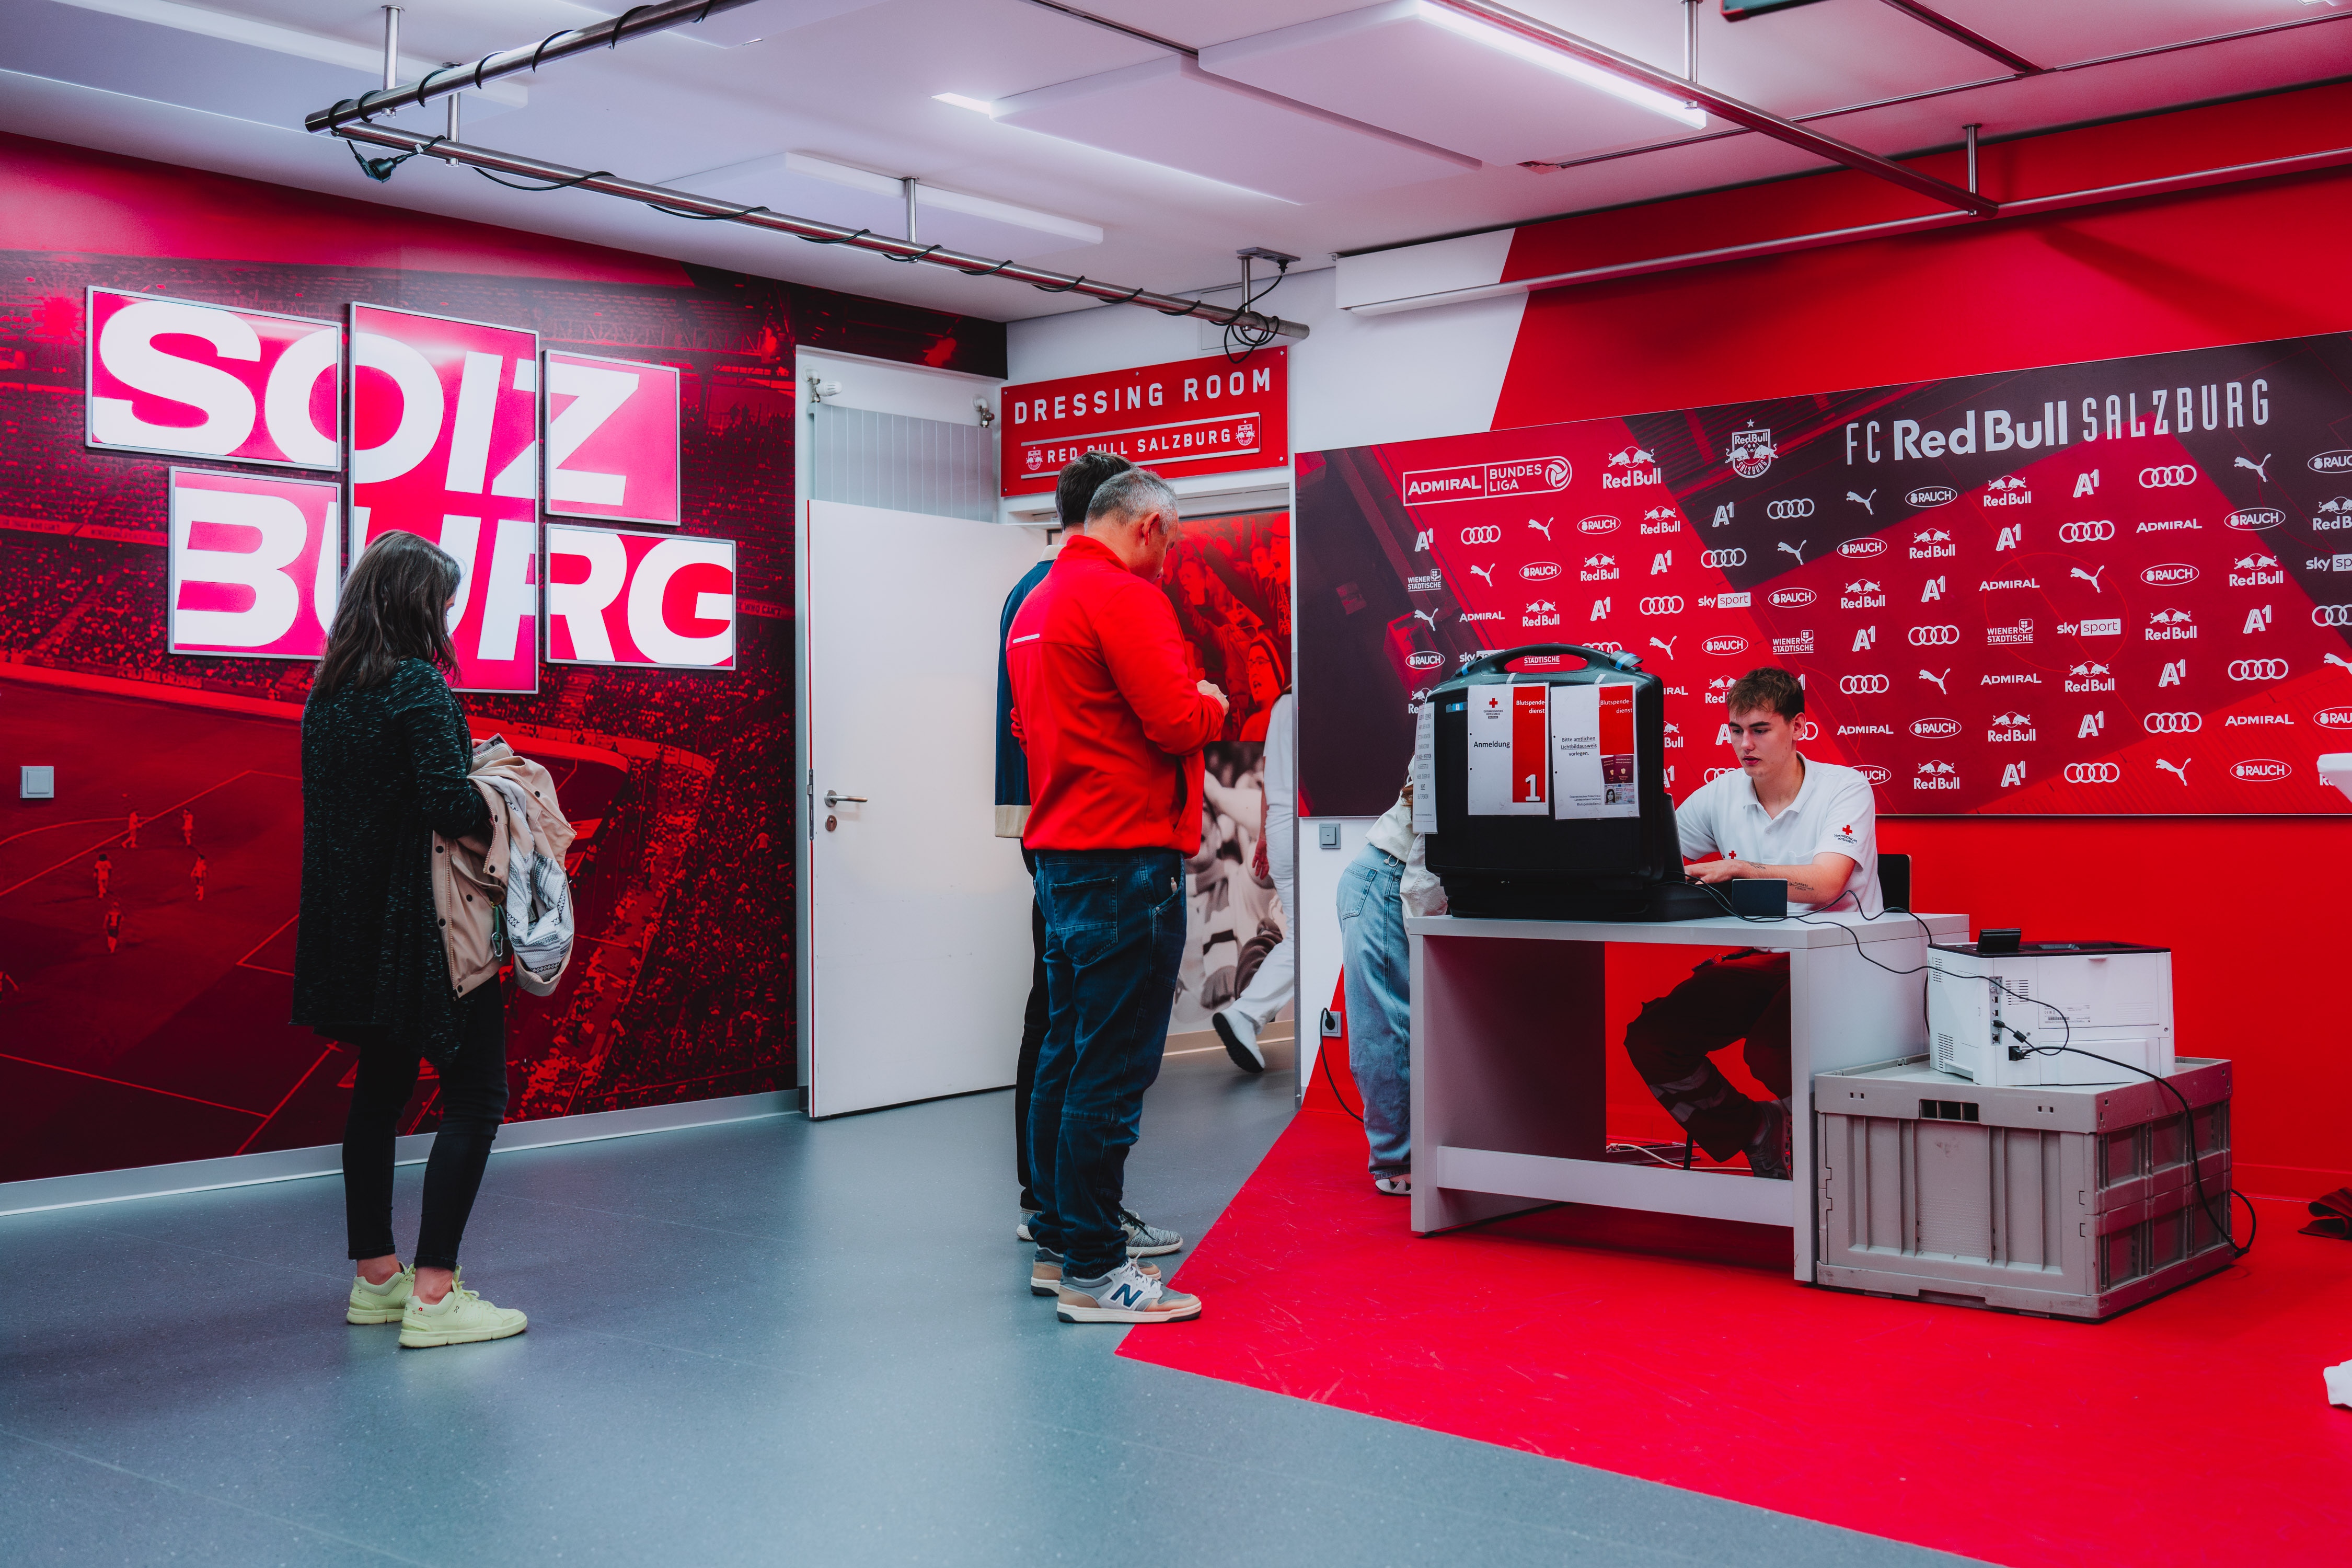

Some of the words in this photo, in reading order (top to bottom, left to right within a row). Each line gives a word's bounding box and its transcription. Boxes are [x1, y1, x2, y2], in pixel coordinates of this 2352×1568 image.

[1015, 383, 1162, 424] DRESSING
[1184, 368, 1270, 401] ROOM
[1847, 421, 1880, 465] FC
[1894, 410, 1976, 460] Red
[1985, 400, 2068, 452] Bull
[2082, 379, 2268, 442] SALZBURG
[1735, 434, 1750, 444] Red
[1751, 432, 1768, 443] Bull
[1047, 445, 1077, 463] RED
[1138, 429, 1230, 452] SALZBURG
[1736, 460, 1767, 475] SALZBURG
[2324, 455, 2352, 468] RAUC
[1408, 476, 1481, 495] ADMIRAL
[1490, 464, 1542, 479] BUNDES
[1490, 479, 1519, 491] LIGA
[1603, 470, 1631, 489] Red
[1633, 468, 1661, 486] Bull
[2073, 469, 2099, 498] A1
[1919, 490, 1951, 502] RAUCH
[1984, 493, 2007, 506] Red
[2009, 491, 2031, 505] Bull
[1712, 502, 1734, 527] A1
[2240, 512, 2278, 525] RAUCH
[1588, 519, 1616, 529] RAUCH
[1641, 522, 1660, 534] Red
[1662, 521, 1680, 533] Bull
[2136, 518, 2202, 533] ADMIRAL
[2313, 516, 2340, 530] Red
[1414, 528, 1433, 552] A1
[1996, 524, 2021, 551] A1
[1850, 542, 1881, 553] RAUCH
[1910, 546, 1931, 559] Red
[1933, 544, 1955, 557] Bull
[1651, 550, 1671, 575] A1
[2306, 557, 2331, 571] sky
[174, 486, 733, 665] BURG
[1530, 566, 1557, 576] RAUCH
[1581, 569, 1599, 581] Red
[1601, 568, 1619, 580] Bull
[2155, 569, 2193, 580] RAUCH
[1408, 581, 1441, 589] STÄDTISCHE
[1979, 578, 2040, 591] ADMIRAL
[2229, 572, 2255, 586] Red
[2258, 571, 2283, 584] Bull
[1921, 575, 1945, 602] A1
[1698, 596, 1716, 608] sky
[1720, 594, 1748, 606] sport
[1781, 592, 1811, 603] RAUCH
[1841, 596, 1862, 608] Red
[1864, 595, 1885, 607] Bull
[1590, 597, 1610, 621] A1
[1459, 611, 1505, 622] ADMIRAL
[1523, 615, 1540, 627] Red
[1542, 614, 1560, 625] Bull
[2243, 605, 2271, 634] A1
[1987, 627, 2019, 635] WIENER
[2057, 622, 2079, 636] sky
[2083, 621, 2118, 635] sport
[2146, 627, 2170, 640] Red
[2172, 626, 2197, 639] Bull
[1773, 638, 1800, 646] WIENER
[1852, 626, 1875, 652] A1
[1987, 632, 2034, 643] STÄDTISCHE
[1714, 640, 1743, 650] RAUCH
[1773, 643, 1814, 652] STÄDTISCHE
[1415, 655, 1441, 665] RAUCH
[1524, 655, 1560, 664] STÄDTISCHE
[1981, 673, 2042, 685] ADMIRAL
[2159, 659, 2185, 687] A1
[1664, 686, 1689, 695] IRAL
[2065, 679, 2089, 692] Red
[2091, 678, 2115, 691] Bull
[1705, 692, 1725, 704] Red
[1408, 704, 1419, 714] Re
[2078, 711, 2104, 738] A1
[2225, 714, 2294, 726] ADMIRAL
[2330, 713, 2352, 723] RAU
[1715, 723, 1732, 745] A
[1837, 724, 1894, 735] ADMIRAL
[1923, 723, 1955, 733] RAUCH
[1664, 736, 1684, 748] Bull
[1988, 730, 2011, 742] Red
[2013, 729, 2036, 741] Bull
[2001, 761, 2025, 787] A1
[2246, 765, 2285, 776] RAUCH
[1525, 774, 1540, 801] 1
[1914, 777, 1936, 789] Red
[1938, 777, 1959, 789] Bull
[1109, 1283, 1144, 1308] N
